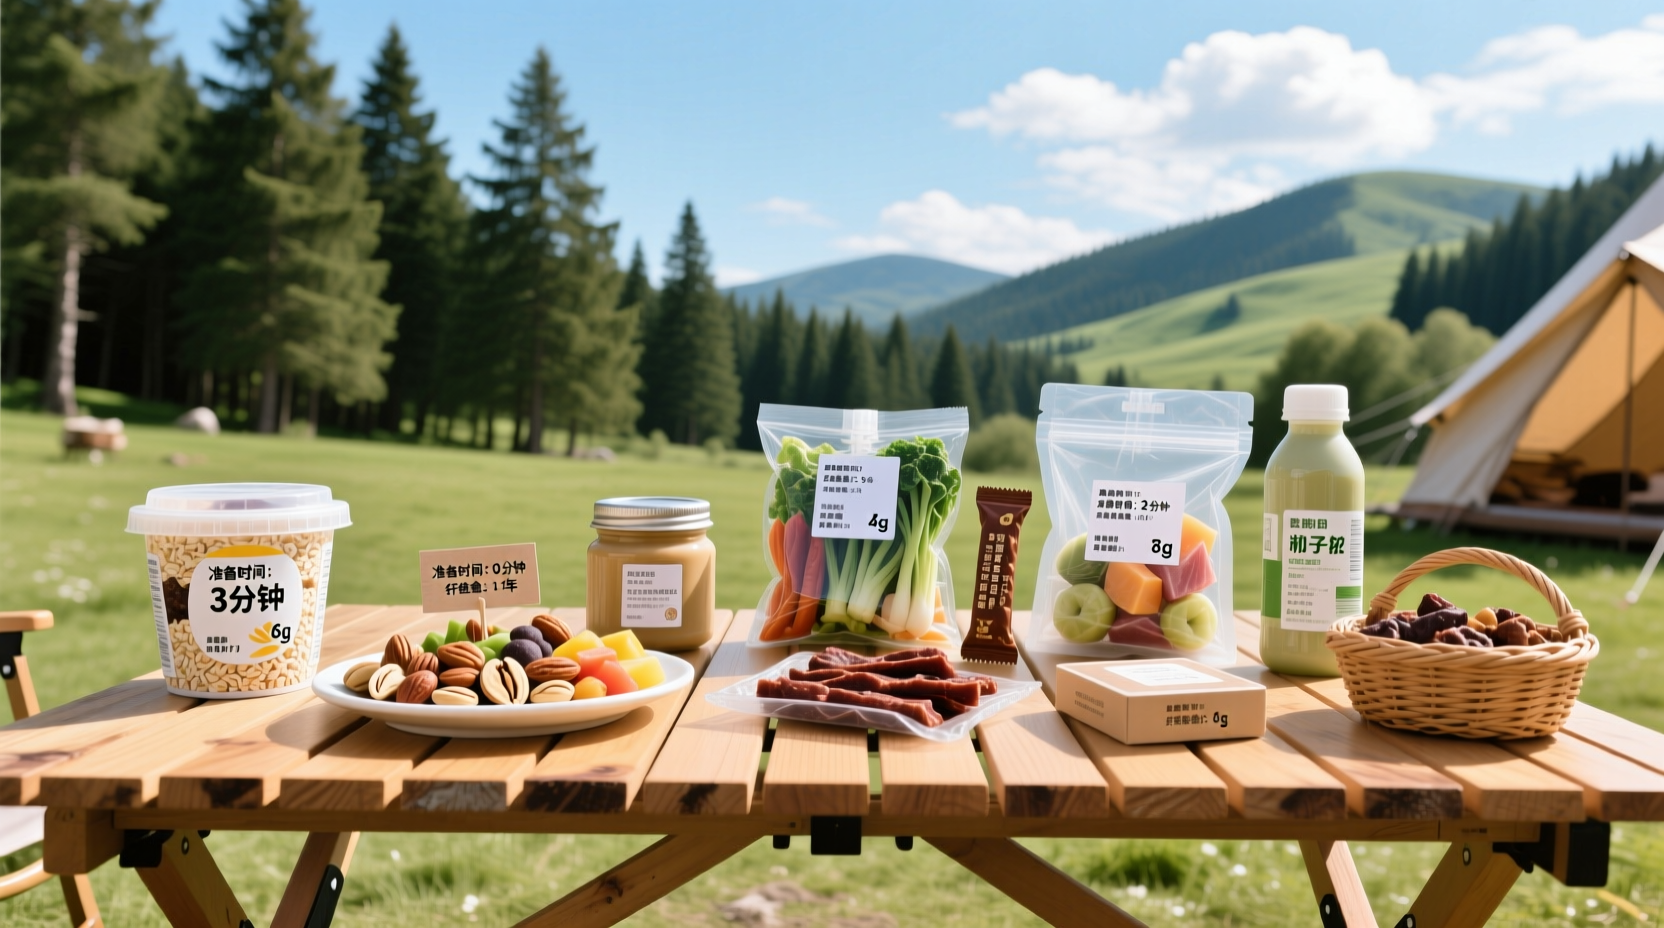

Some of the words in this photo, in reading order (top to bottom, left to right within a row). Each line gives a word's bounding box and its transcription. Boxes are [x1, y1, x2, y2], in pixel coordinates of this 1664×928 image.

[1151, 538, 1173, 559] 8g
[210, 582, 285, 614] 3分钟
[271, 623, 291, 644] 6g
